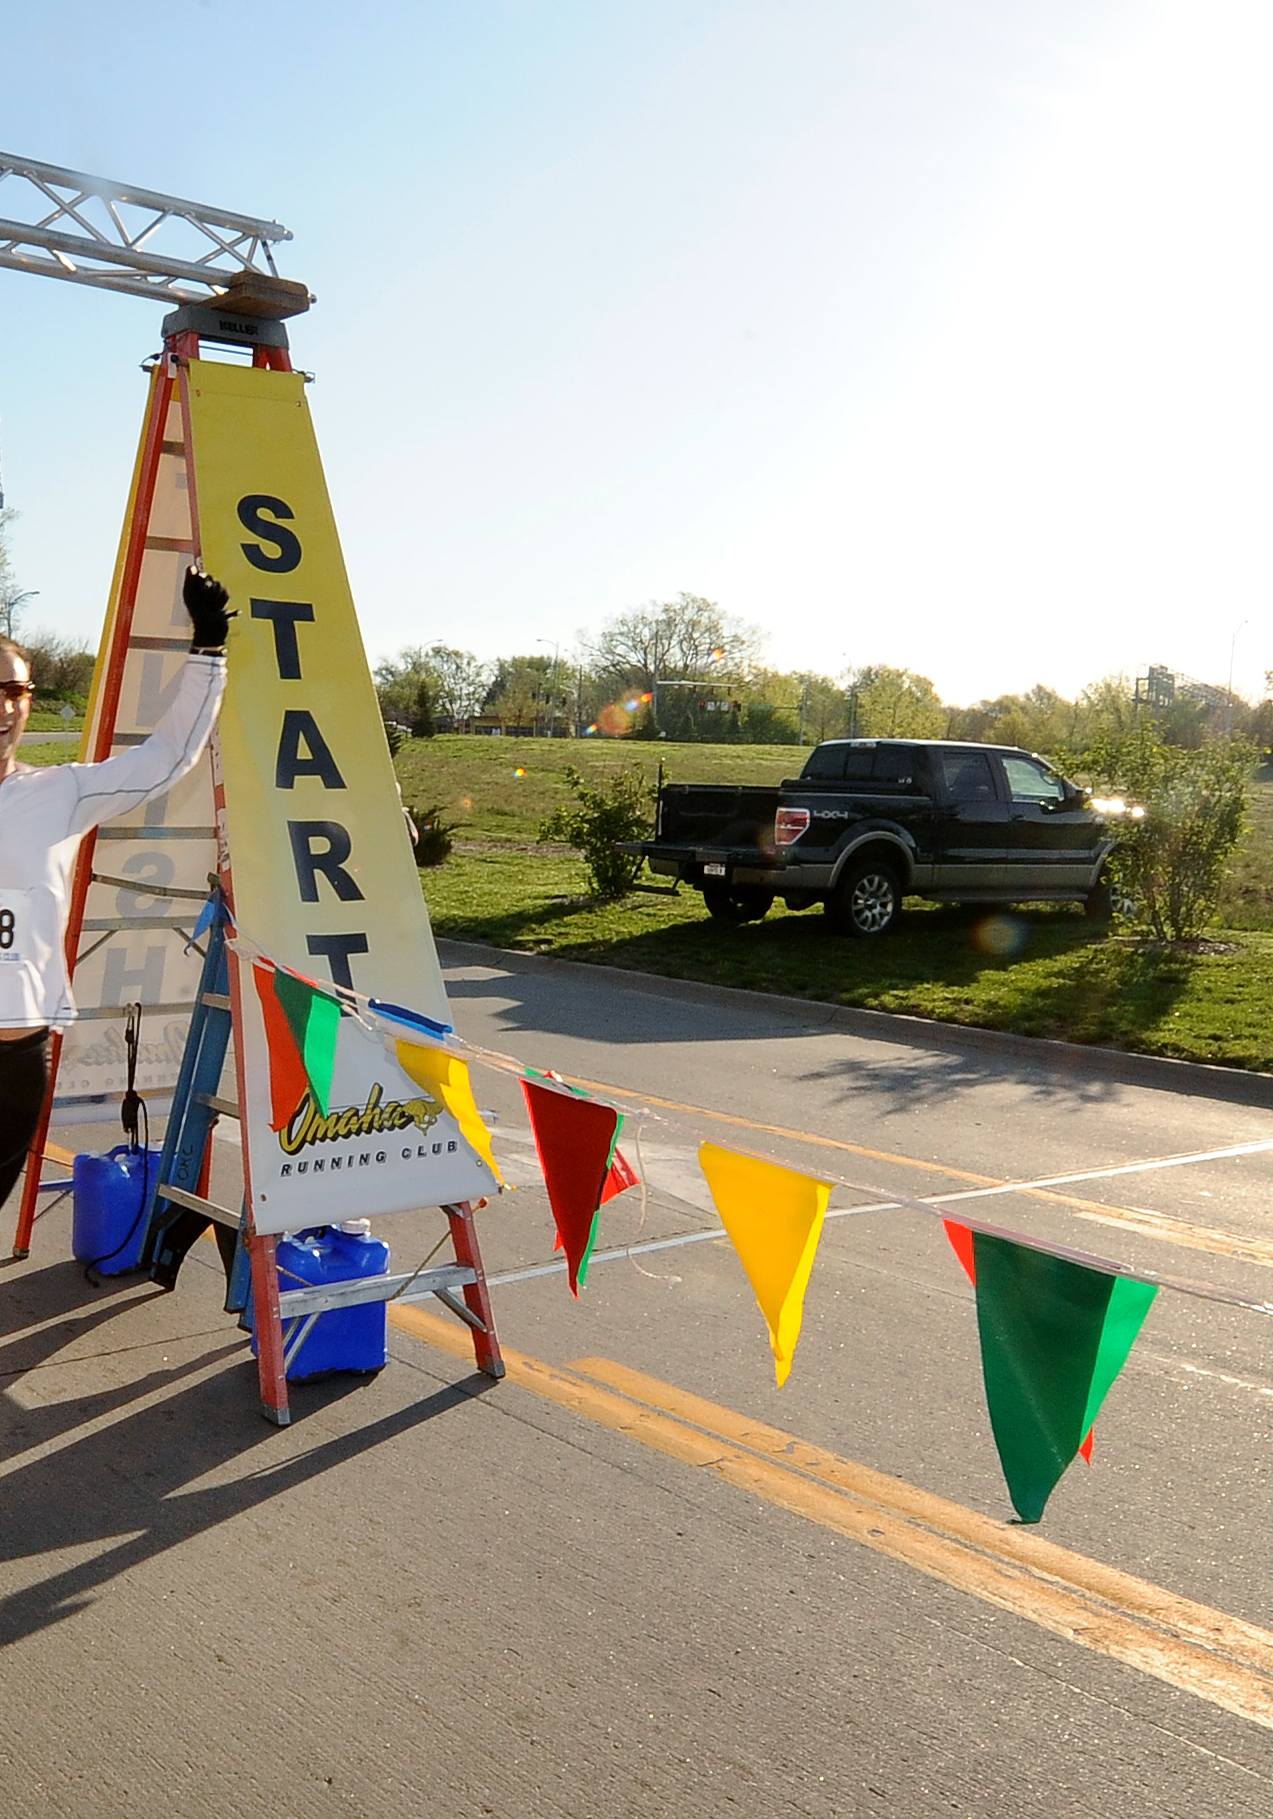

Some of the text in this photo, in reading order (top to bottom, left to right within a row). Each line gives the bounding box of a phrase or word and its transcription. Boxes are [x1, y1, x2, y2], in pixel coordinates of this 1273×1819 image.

[235, 493, 369, 1017] START
[279, 1082, 414, 1156] Omaha
[280, 1140, 458, 1177] RUNNING CLUB
